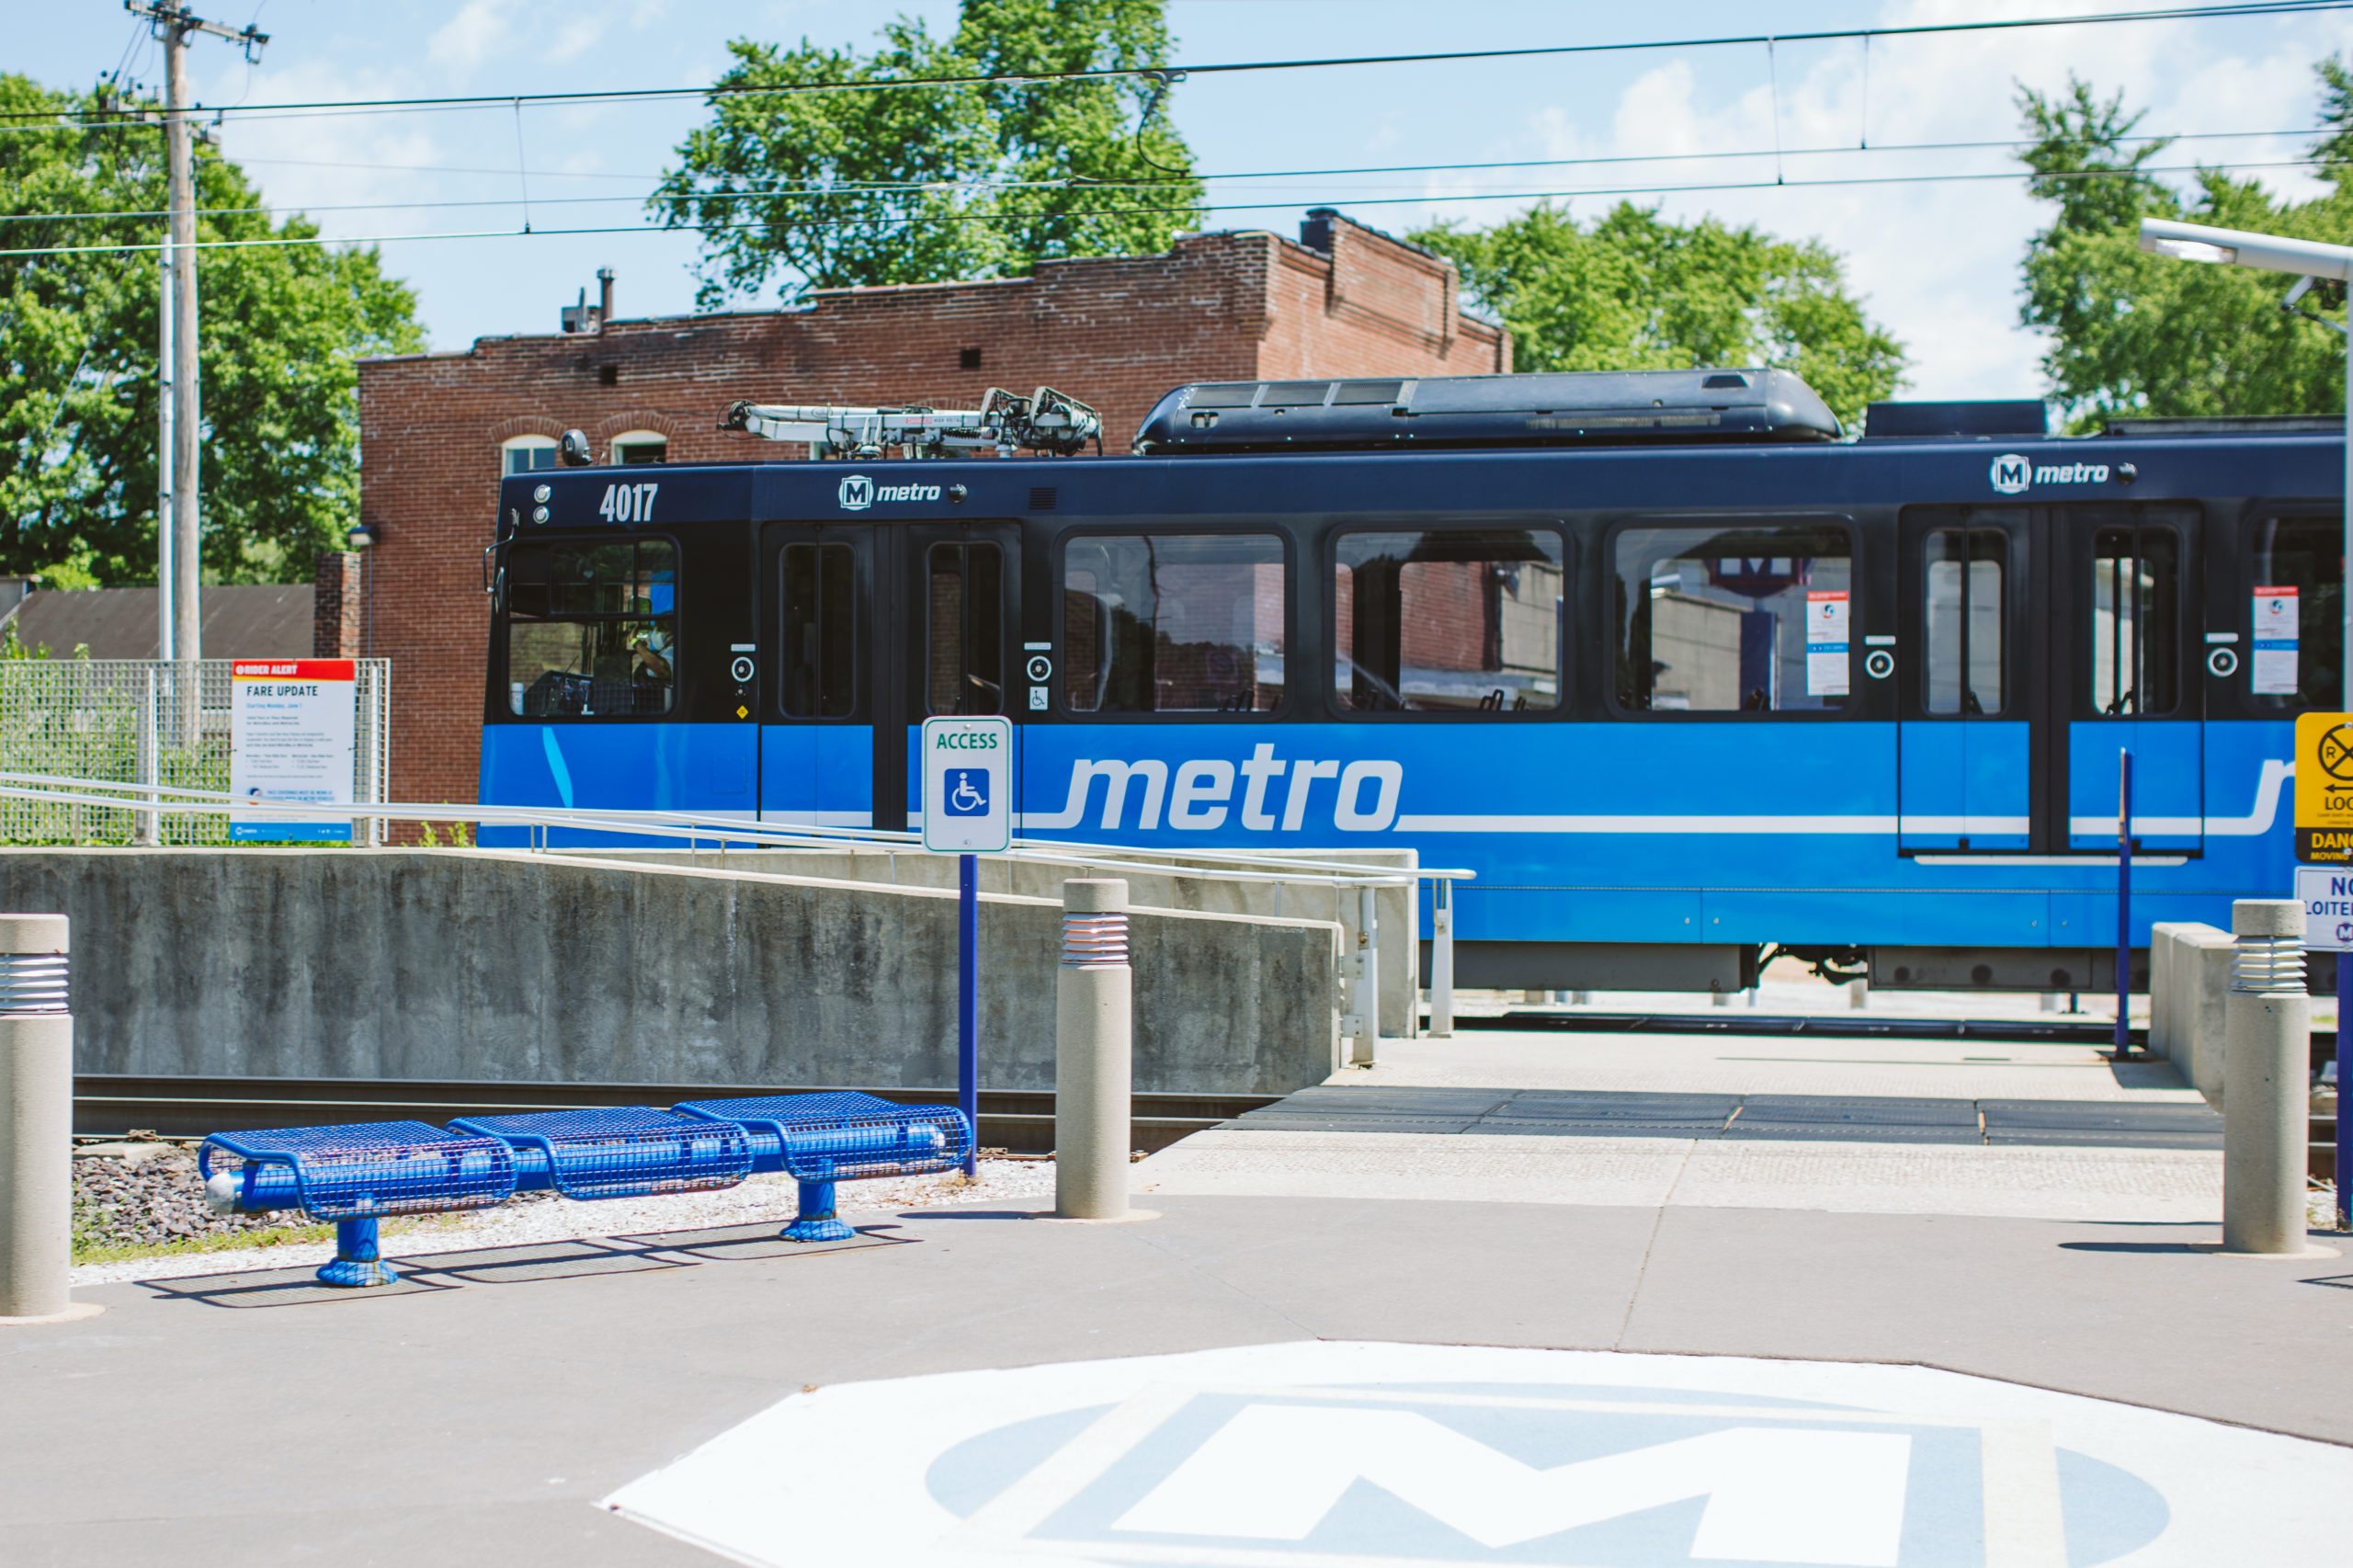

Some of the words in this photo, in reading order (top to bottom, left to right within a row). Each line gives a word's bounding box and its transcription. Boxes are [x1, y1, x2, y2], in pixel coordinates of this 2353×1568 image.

[2034, 461, 2110, 484] metro
[876, 483, 941, 502] metro
[598, 483, 659, 523] 4017
[244, 665, 270, 675] RIDER
[270, 665, 298, 675] ALERT
[246, 686, 274, 697] FARE
[277, 686, 319, 697] UPDATE
[936, 733, 998, 750] ACCESS
[2325, 745, 2336, 759] R
[1063, 743, 1404, 832] metro
[2311, 833, 2353, 849] DAN
[2304, 901, 2353, 916] LOITE
